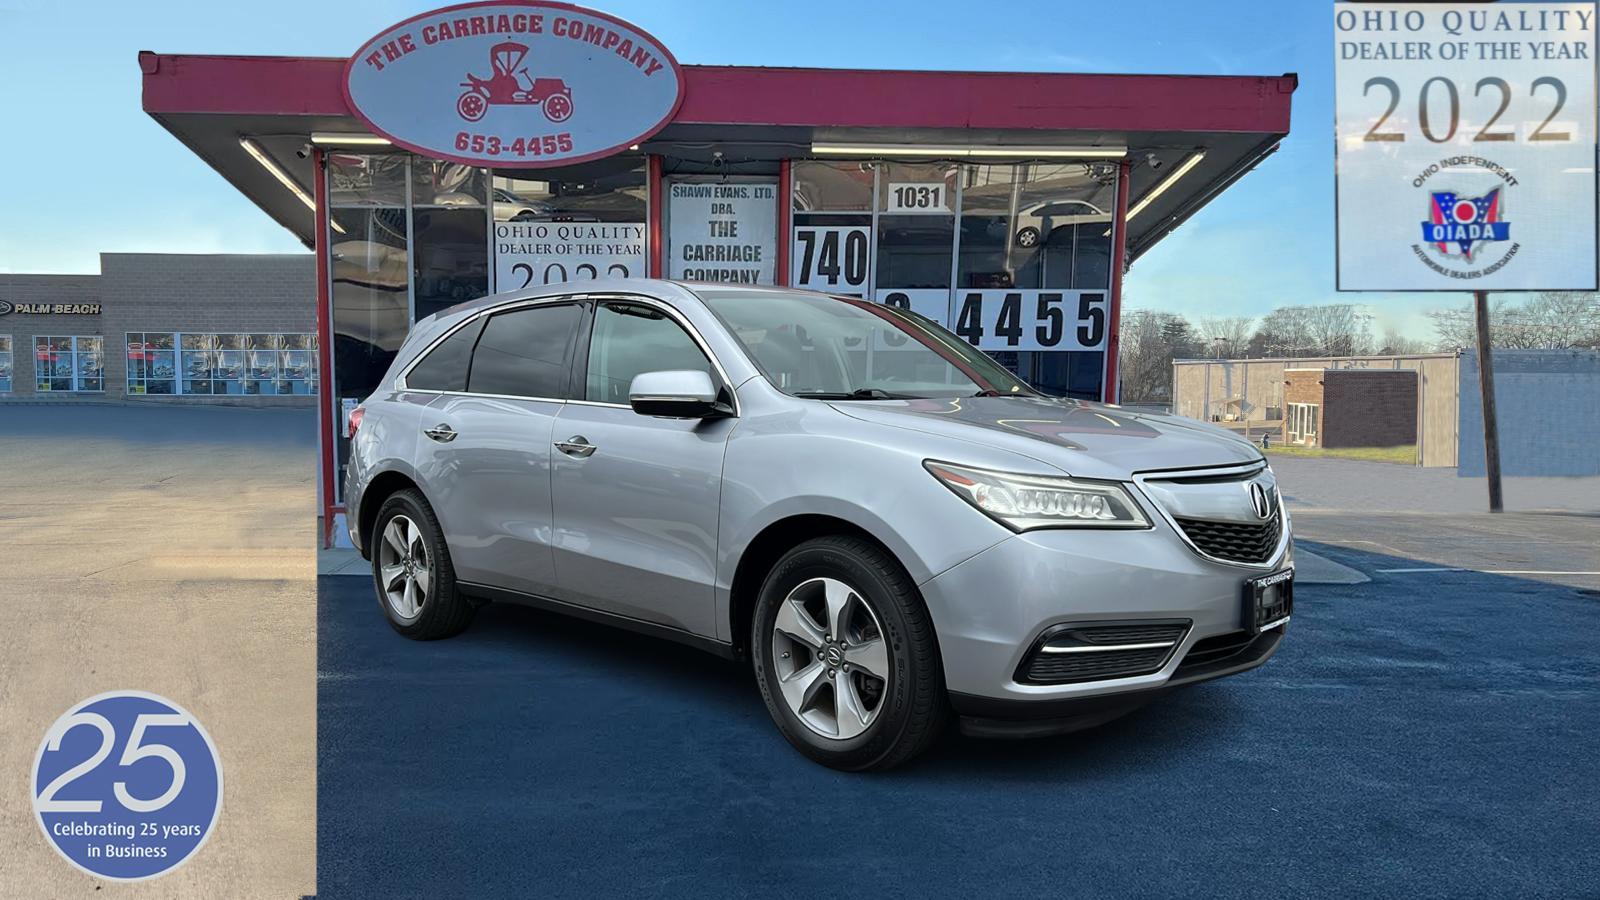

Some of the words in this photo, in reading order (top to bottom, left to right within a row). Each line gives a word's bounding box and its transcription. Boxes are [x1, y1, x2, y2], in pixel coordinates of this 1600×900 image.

[1336, 10, 1425, 32] OHIO
[1442, 10, 1593, 36] QUALITY
[366, 33, 417, 72] THE
[422, 14, 544, 46] CARRIAGE
[552, 17, 664, 77] COMPANY
[1340, 41, 1433, 60] DEALER
[1439, 41, 1469, 60] OF
[1475, 41, 1522, 60] THE
[1528, 41, 1589, 60] YEAR
[1363, 76, 1571, 143] 2022
[455, 132, 573, 156] 653-4455
[1412, 164, 1440, 188] OHIO
[1440, 155, 1520, 188] INDEPENDENT
[673, 186, 712, 198] SHAWN
[714, 187, 751, 199] EVANS.
[754, 187, 775, 199] LTD.
[894, 186, 940, 208] 1031
[711, 203, 736, 215] DBA.
[497, 226, 548, 238] OHIO
[558, 225, 645, 240] QUALITY
[709, 220, 738, 238] THE
[1432, 224, 1496, 241] OIADA
[499, 243, 551, 255] DEALER
[555, 243, 574, 255] OF
[576, 243, 603, 255] THE
[606, 243, 641, 255] YEAR
[683, 244, 762, 262] CARRIAGE
[798, 230, 868, 285] 740
[1411, 244, 1450, 278] AUTOMOBILE
[1450, 269, 1482, 280] DEALERS
[1483, 242, 1521, 276] ASSOCIATION
[683, 268, 761, 284] COMPANY
[15, 303, 51, 314] PALM
[55, 303, 101, 314] BEACH
